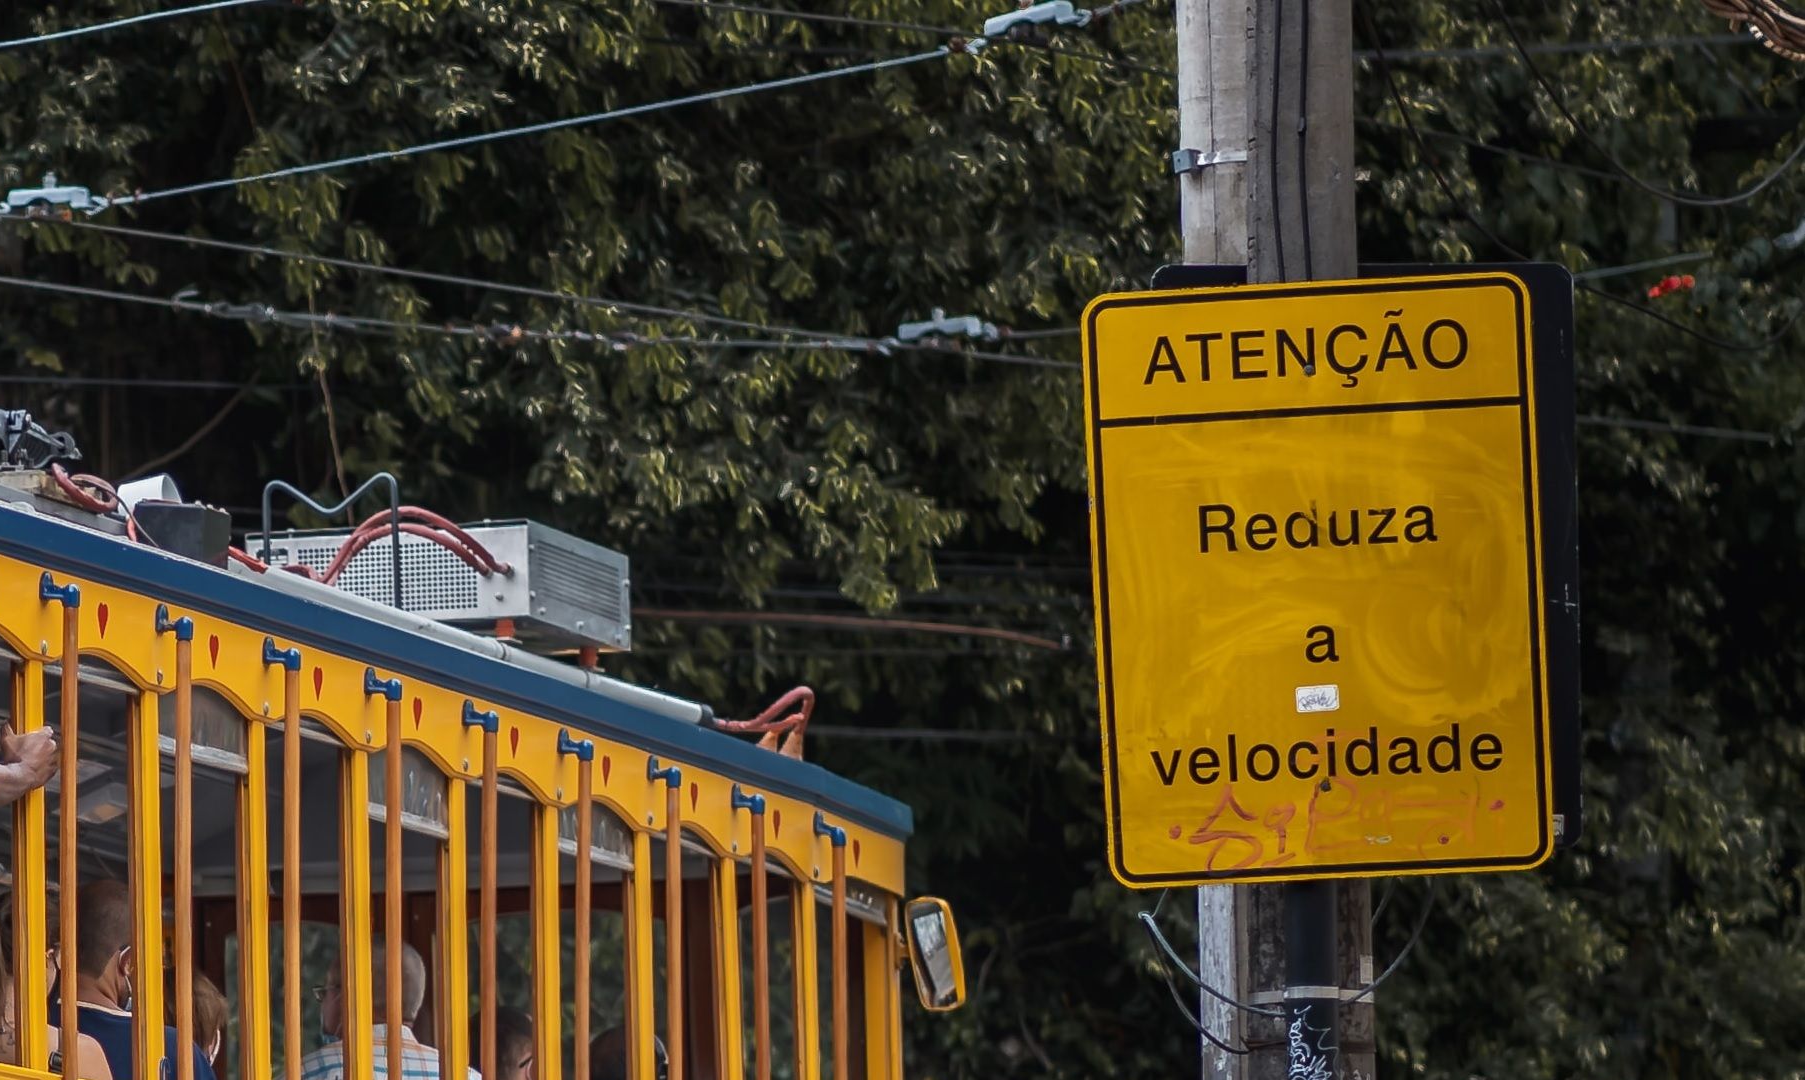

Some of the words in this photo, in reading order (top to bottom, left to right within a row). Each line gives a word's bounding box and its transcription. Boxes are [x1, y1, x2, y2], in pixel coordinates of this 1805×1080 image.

[1144, 308, 1469, 388] ATENÇÃO
[1198, 499, 1438, 554] Reduza
[1305, 625, 1339, 663] a
[1150, 723, 1503, 786] velocidade
